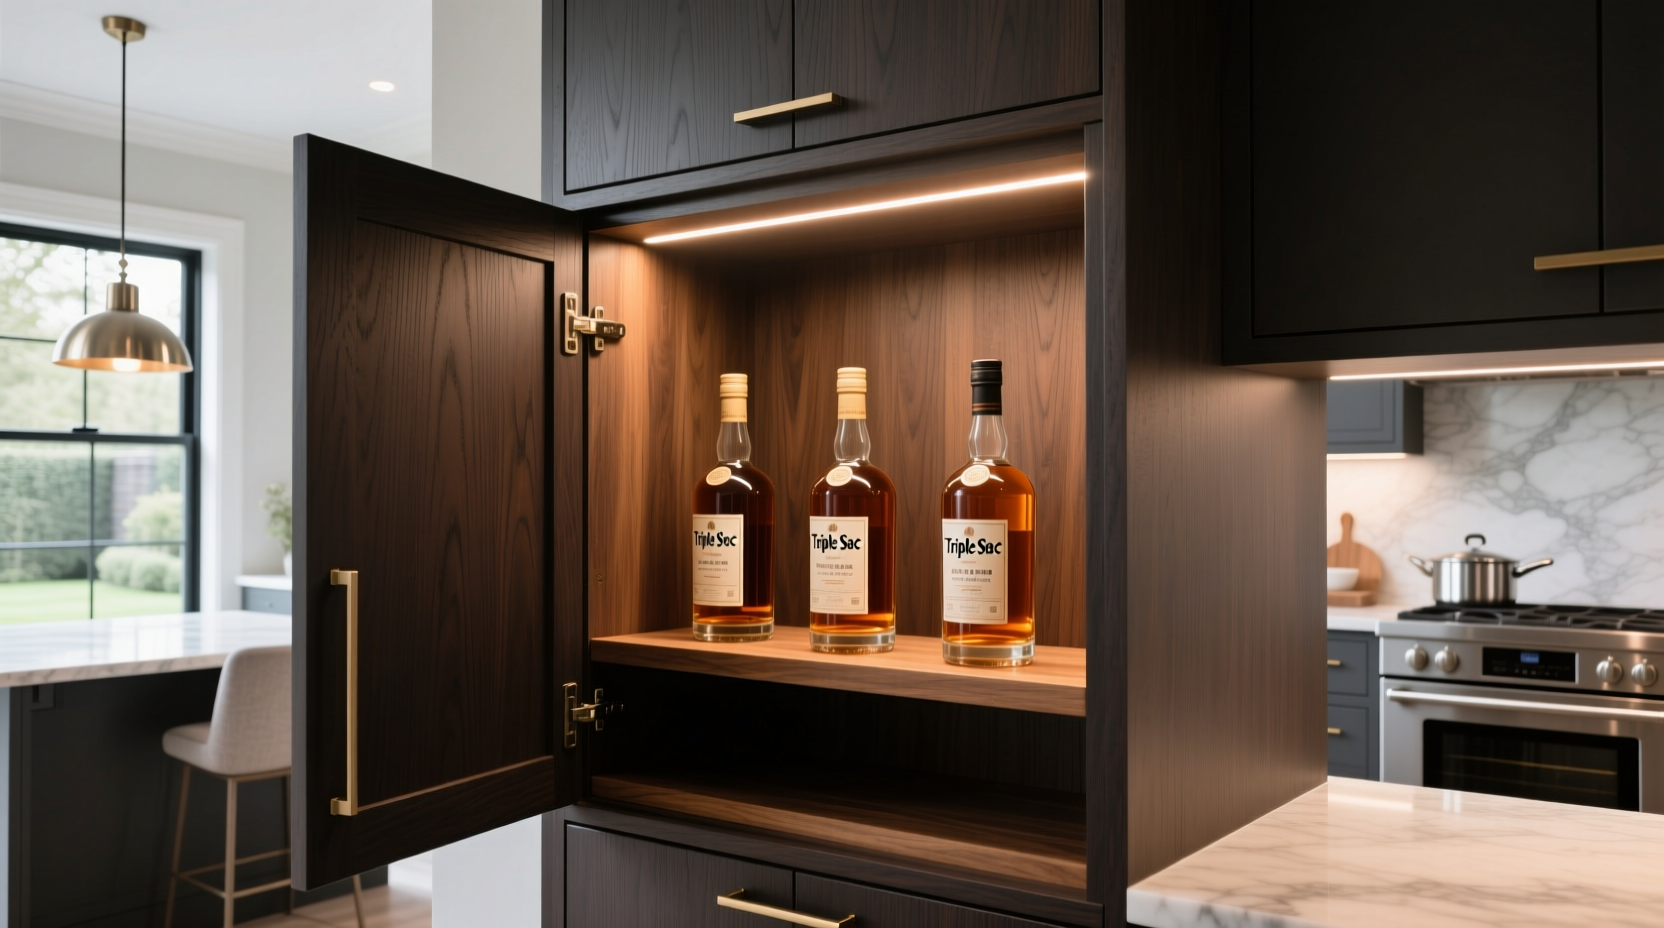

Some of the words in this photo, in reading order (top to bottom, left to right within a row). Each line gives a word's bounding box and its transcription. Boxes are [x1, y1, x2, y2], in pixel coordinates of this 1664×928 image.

[694, 531, 715, 550] Triple
[811, 533, 838, 553] Triple
[840, 534, 862, 550] Sac
[944, 537, 976, 558] Triple
